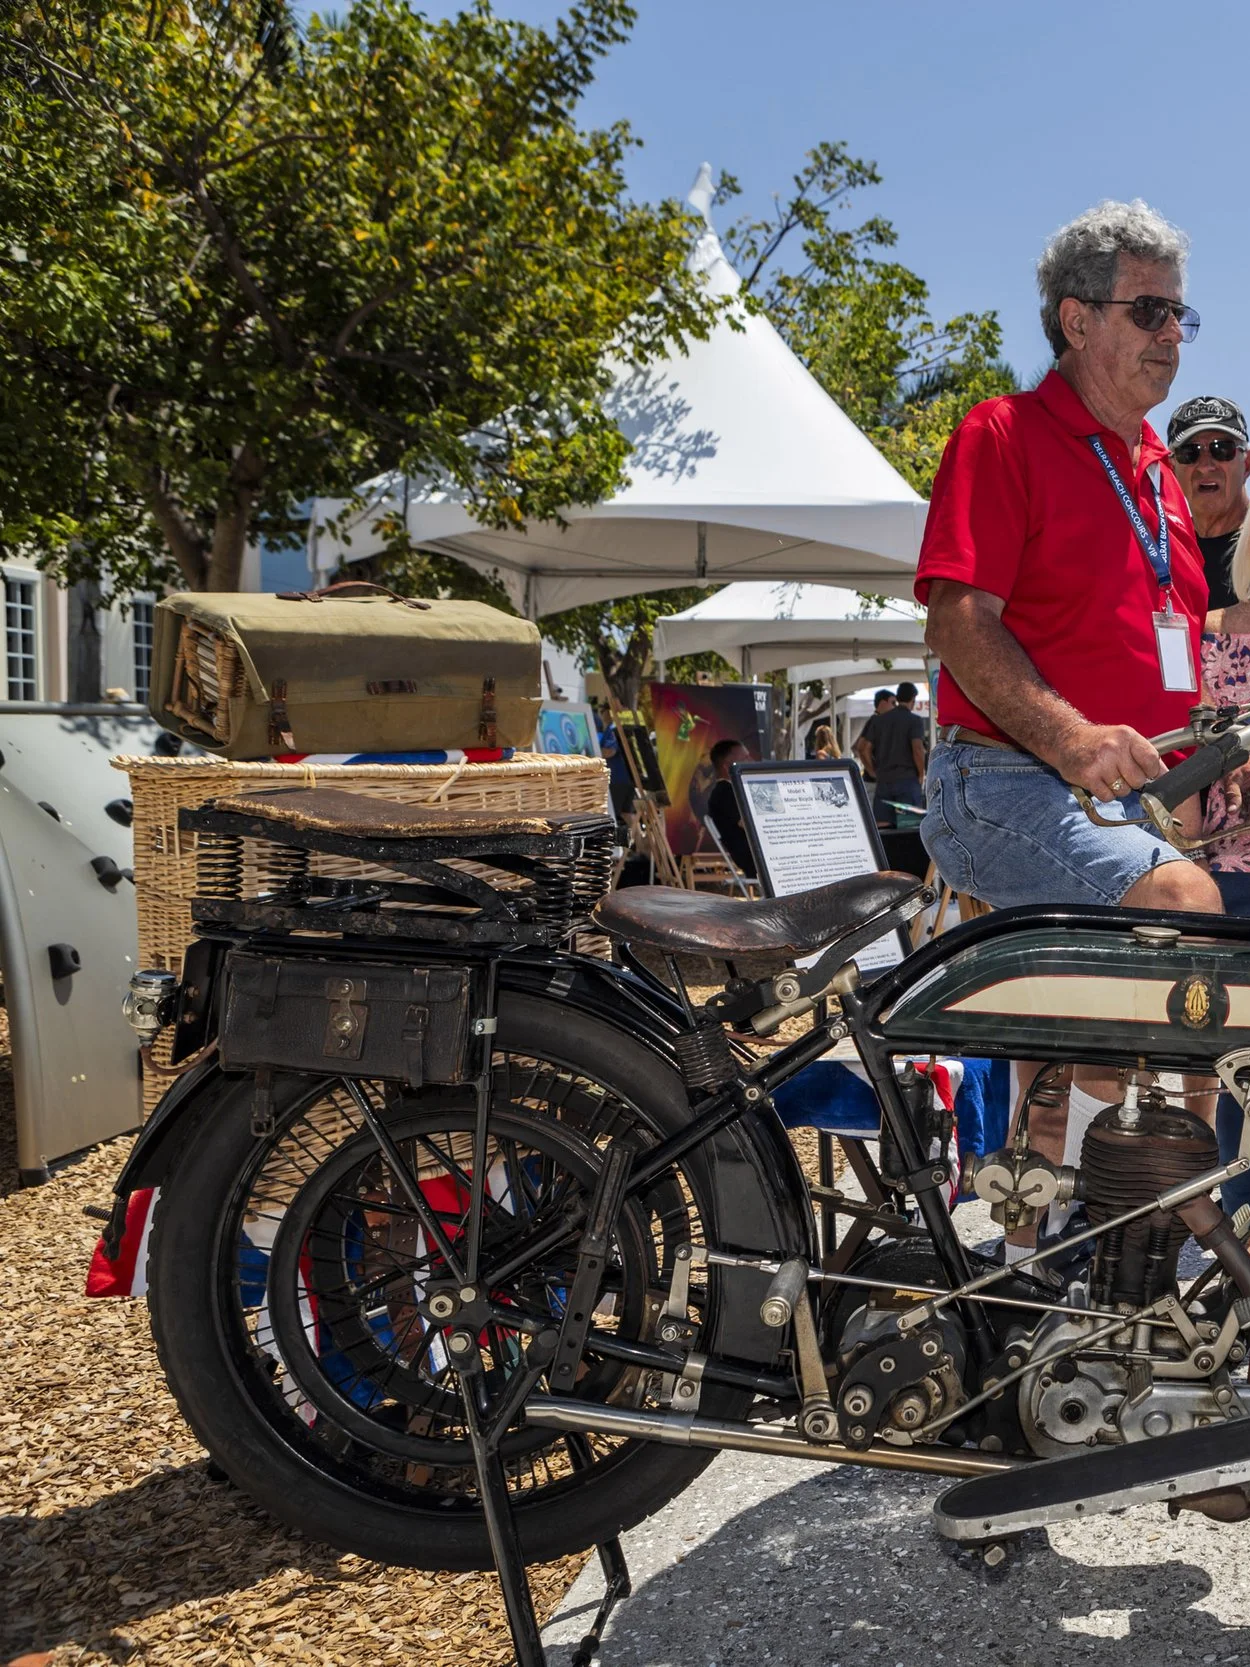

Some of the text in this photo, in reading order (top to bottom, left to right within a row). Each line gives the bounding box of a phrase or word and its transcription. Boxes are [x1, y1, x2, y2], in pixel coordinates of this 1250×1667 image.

[1093, 442, 1113, 469] DELRAY
[1109, 469, 1127, 495] BEACH
[1122, 494, 1149, 539] CONCOURS
[1148, 544, 1158, 558] VIP
